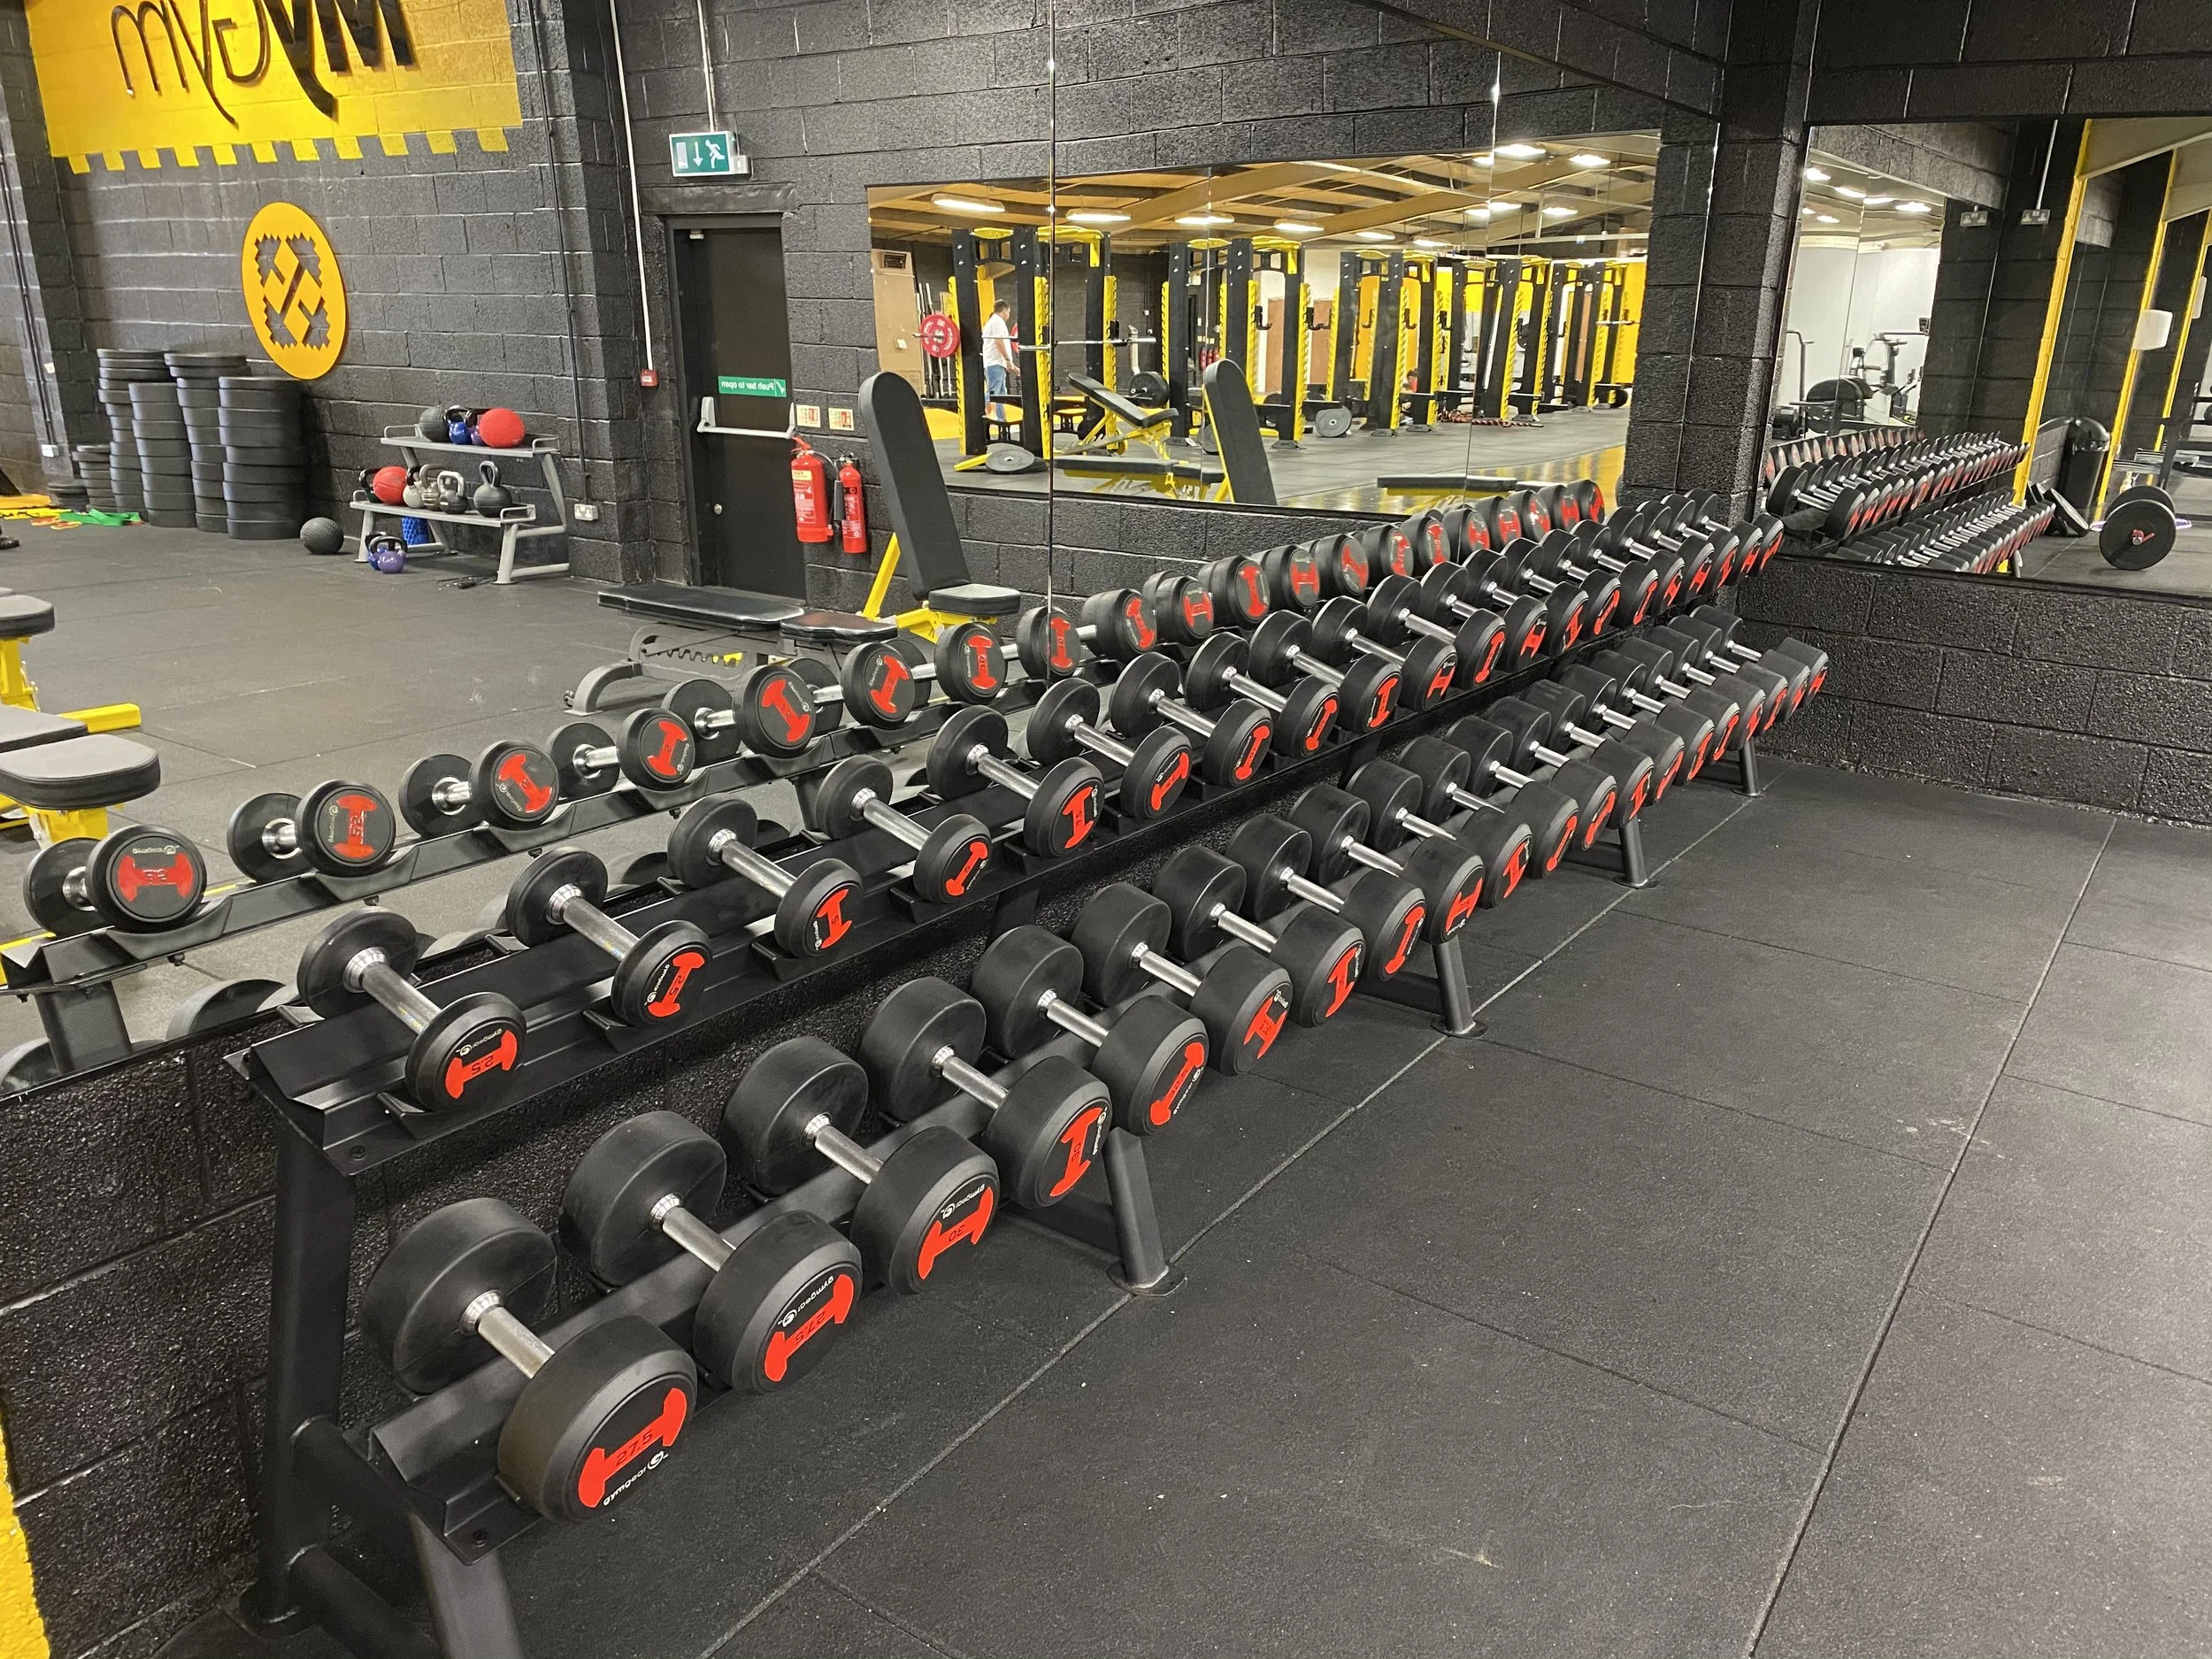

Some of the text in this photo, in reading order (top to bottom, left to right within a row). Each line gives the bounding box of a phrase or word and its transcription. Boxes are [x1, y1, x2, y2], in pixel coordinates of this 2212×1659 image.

[832, 915, 839, 924] 5
[472, 1028, 503, 1049] gymgear
[472, 1055, 494, 1076] 2.5
[1071, 1143, 1082, 1162] 30
[956, 1184, 986, 1210] gymgear
[949, 1225, 965, 1242] 30
[797, 1274, 833, 1314] gymgear
[795, 1310, 826, 1346] 27.5
[616, 1430, 654, 1467] 27.5
[602, 1465, 648, 1508] gymgear
